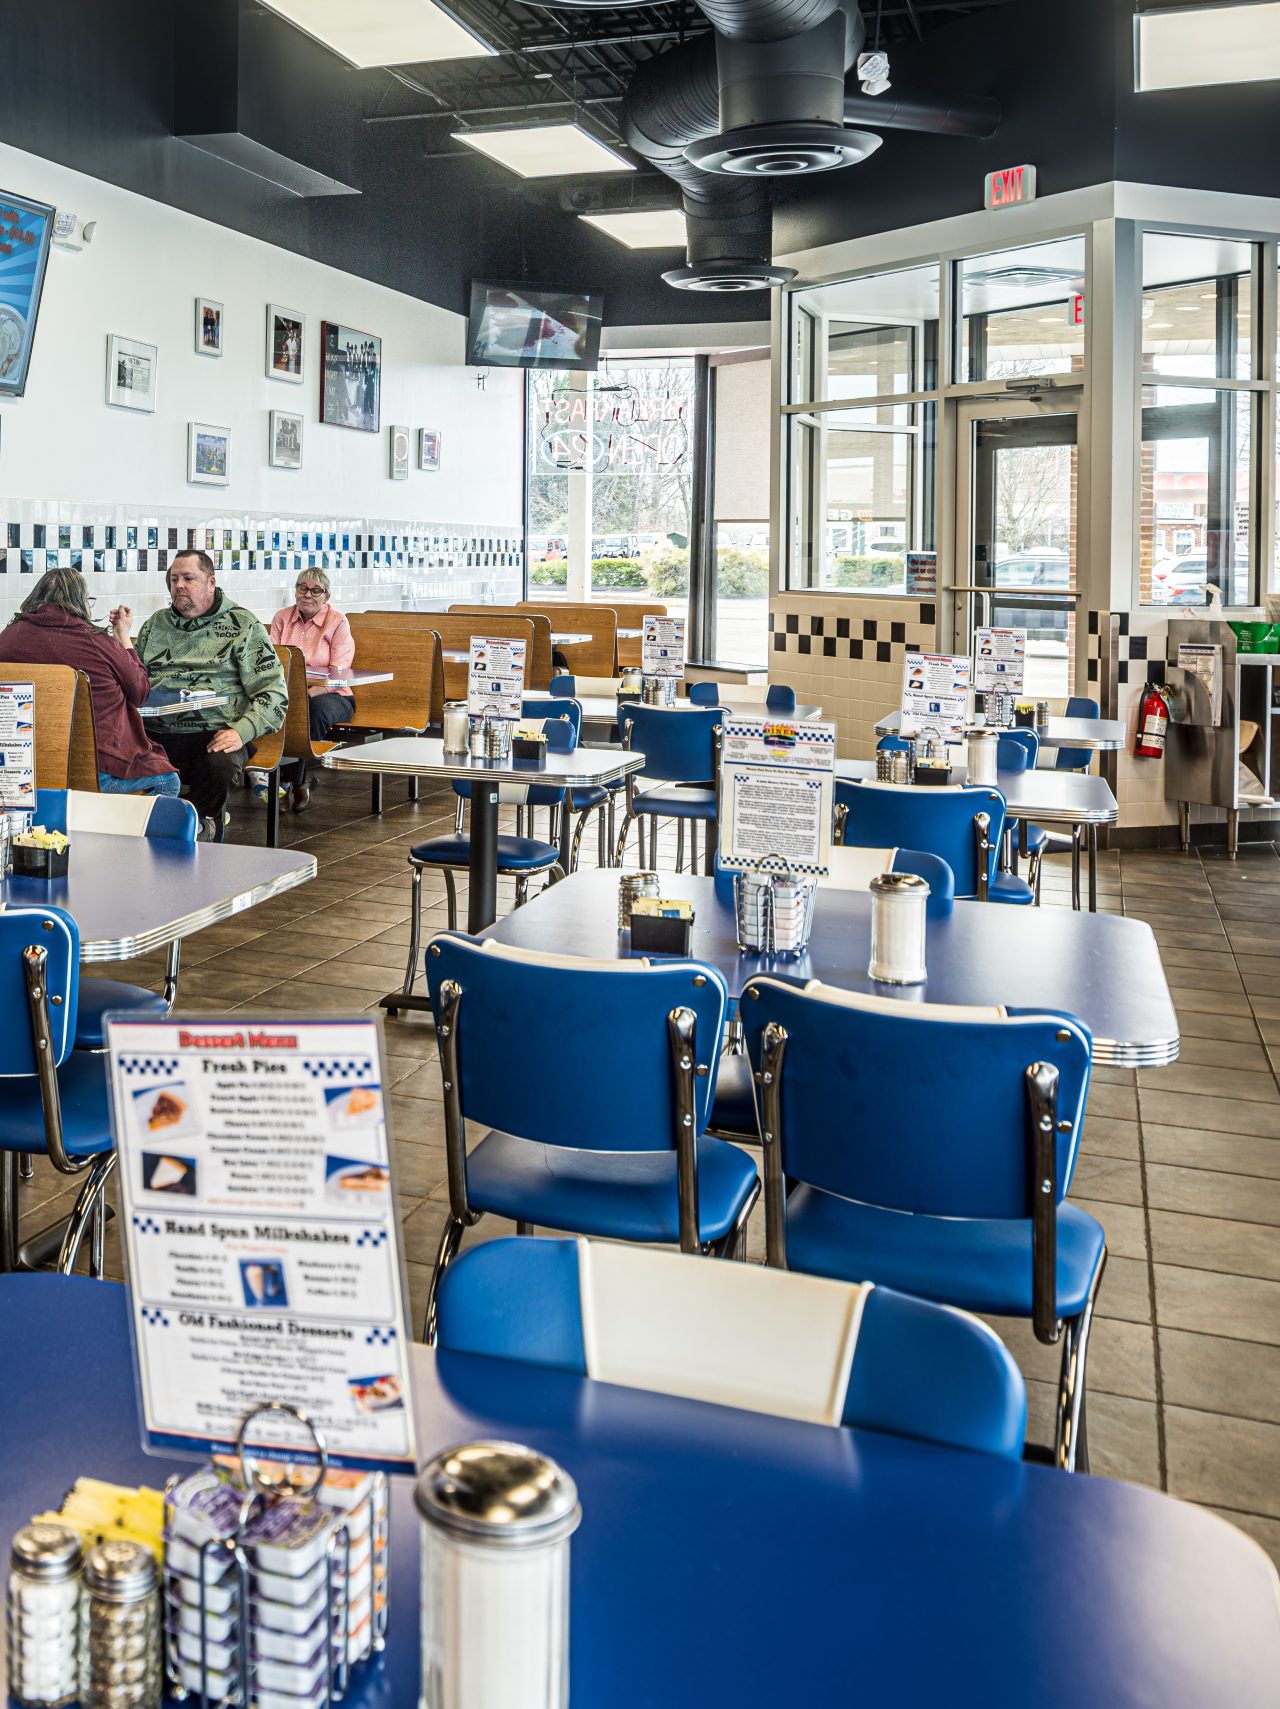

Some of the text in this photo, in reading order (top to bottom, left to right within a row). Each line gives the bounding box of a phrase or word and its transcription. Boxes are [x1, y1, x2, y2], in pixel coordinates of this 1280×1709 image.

[991, 167, 1024, 206] EXIT
[4, 207, 19, 224] with
[179, 1030, 297, 1048] Dessert Menu
[203, 1059, 287, 1073] Fresh Pies
[165, 1221, 350, 1244] Hand Spun Milkshakes
[179, 1313, 353, 1340] Old Fashioned Desserts
